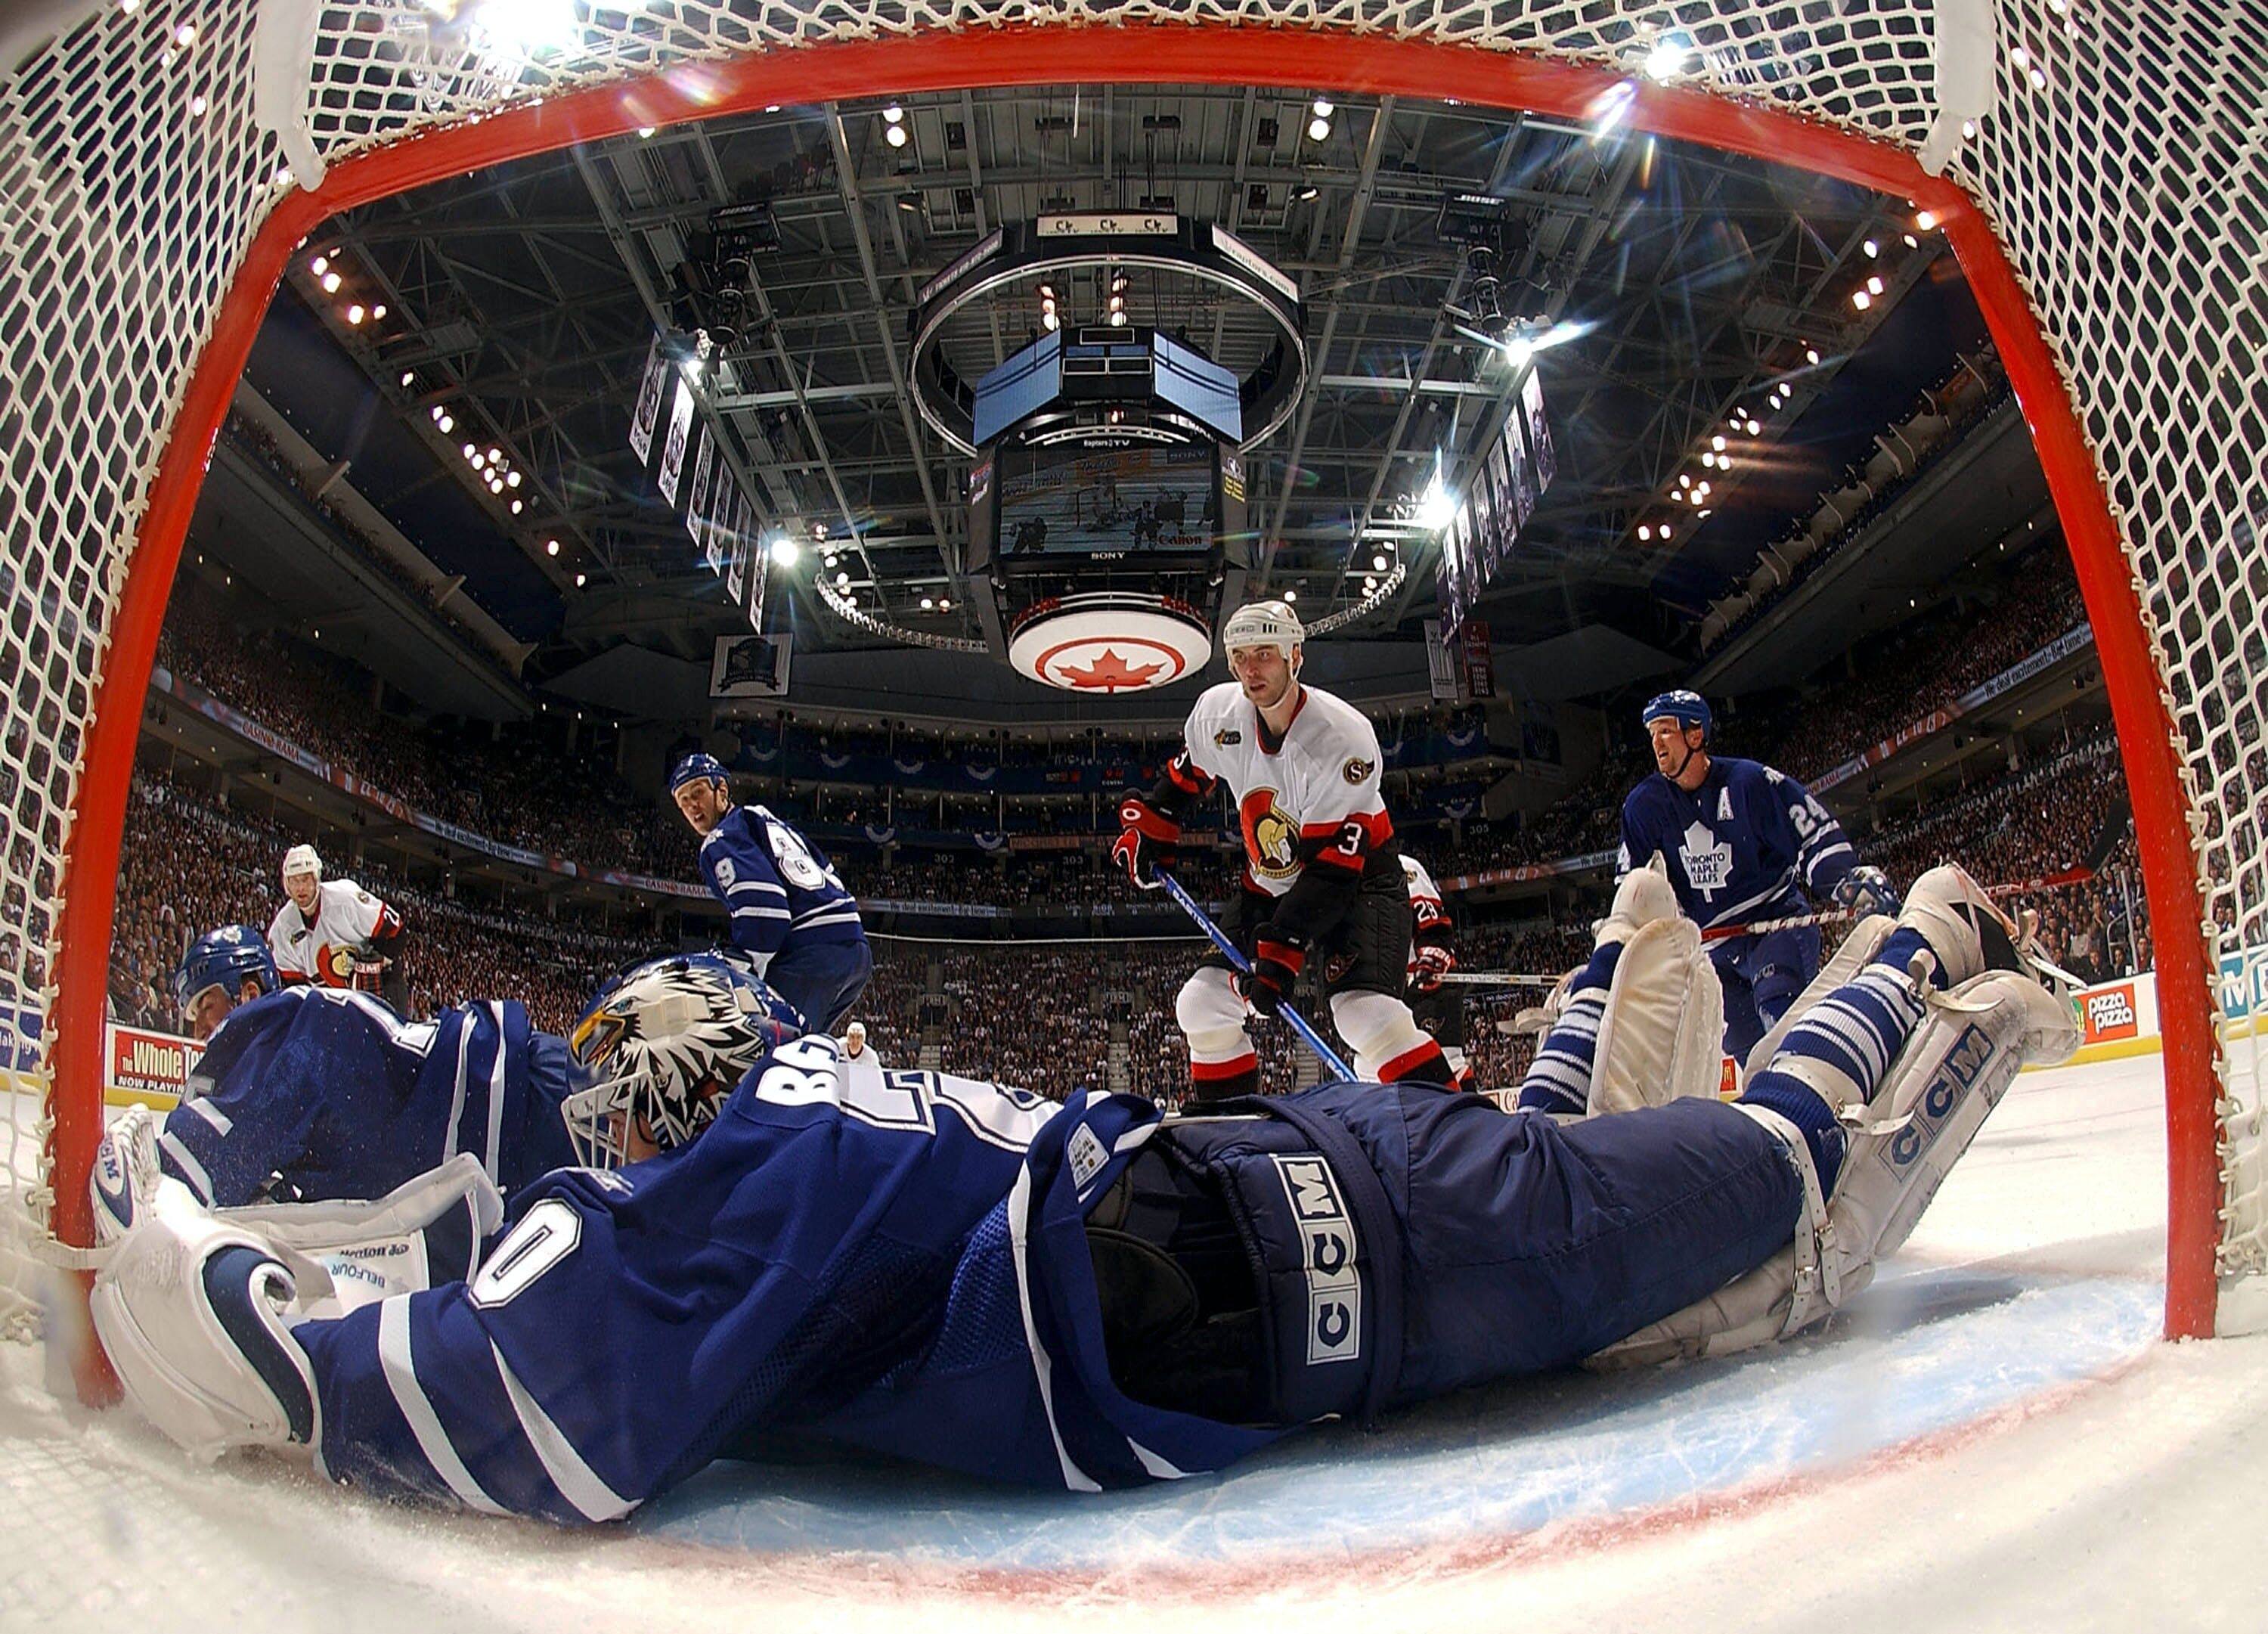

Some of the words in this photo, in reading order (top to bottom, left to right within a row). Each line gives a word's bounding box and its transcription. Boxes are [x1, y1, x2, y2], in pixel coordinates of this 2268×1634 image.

[1157, 535, 1203, 545] Canon
[1091, 551, 1126, 560] SONY
[1717, 786, 1734, 821] A
[1789, 794, 1830, 839] 24
[1337, 822, 1362, 856] 3
[1684, 851, 1726, 865] TORONTO
[1690, 863, 1719, 873] MAPLE
[1693, 872, 1719, 884] LEAFS
[2087, 991, 2127, 1020] pizza
[2095, 1006, 2133, 1035] pizza
[133, 1040, 183, 1080] Whole
[118, 1075, 146, 1088] NOW
[147, 1079, 185, 1095] PLAYIN
[1891, 1024, 1995, 1166] CCM
[1284, 1161, 1352, 1347] CCM
[331, 1263, 386, 1289] BELFOUR
